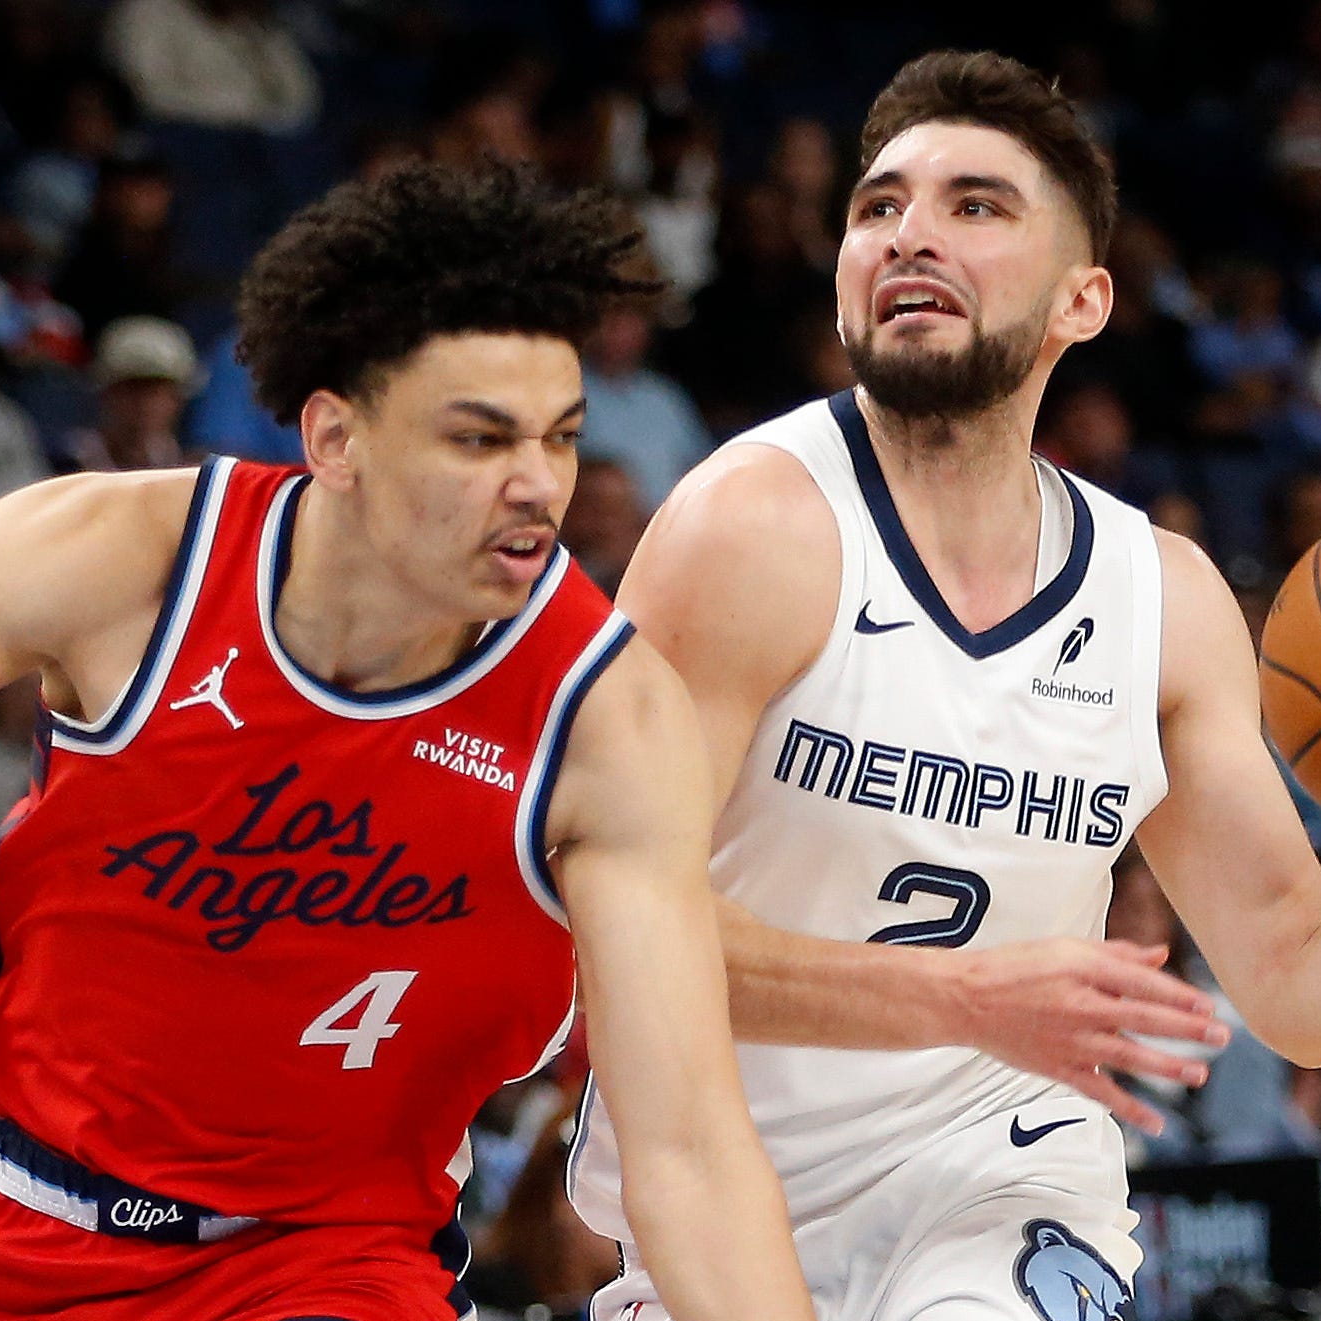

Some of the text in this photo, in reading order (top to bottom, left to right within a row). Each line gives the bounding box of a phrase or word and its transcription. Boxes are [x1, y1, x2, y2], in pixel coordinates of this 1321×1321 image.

[1031, 678, 1114, 706] Robinhood
[412, 740, 515, 792] RWANDA
[444, 730, 505, 764] VISIT
[773, 718, 1130, 849] MEMPHIS
[213, 763, 380, 857] Los
[99, 844, 476, 953] Angeles
[865, 861, 991, 950] 2
[298, 970, 419, 1070] 4
[110, 1197, 184, 1232] Clips
